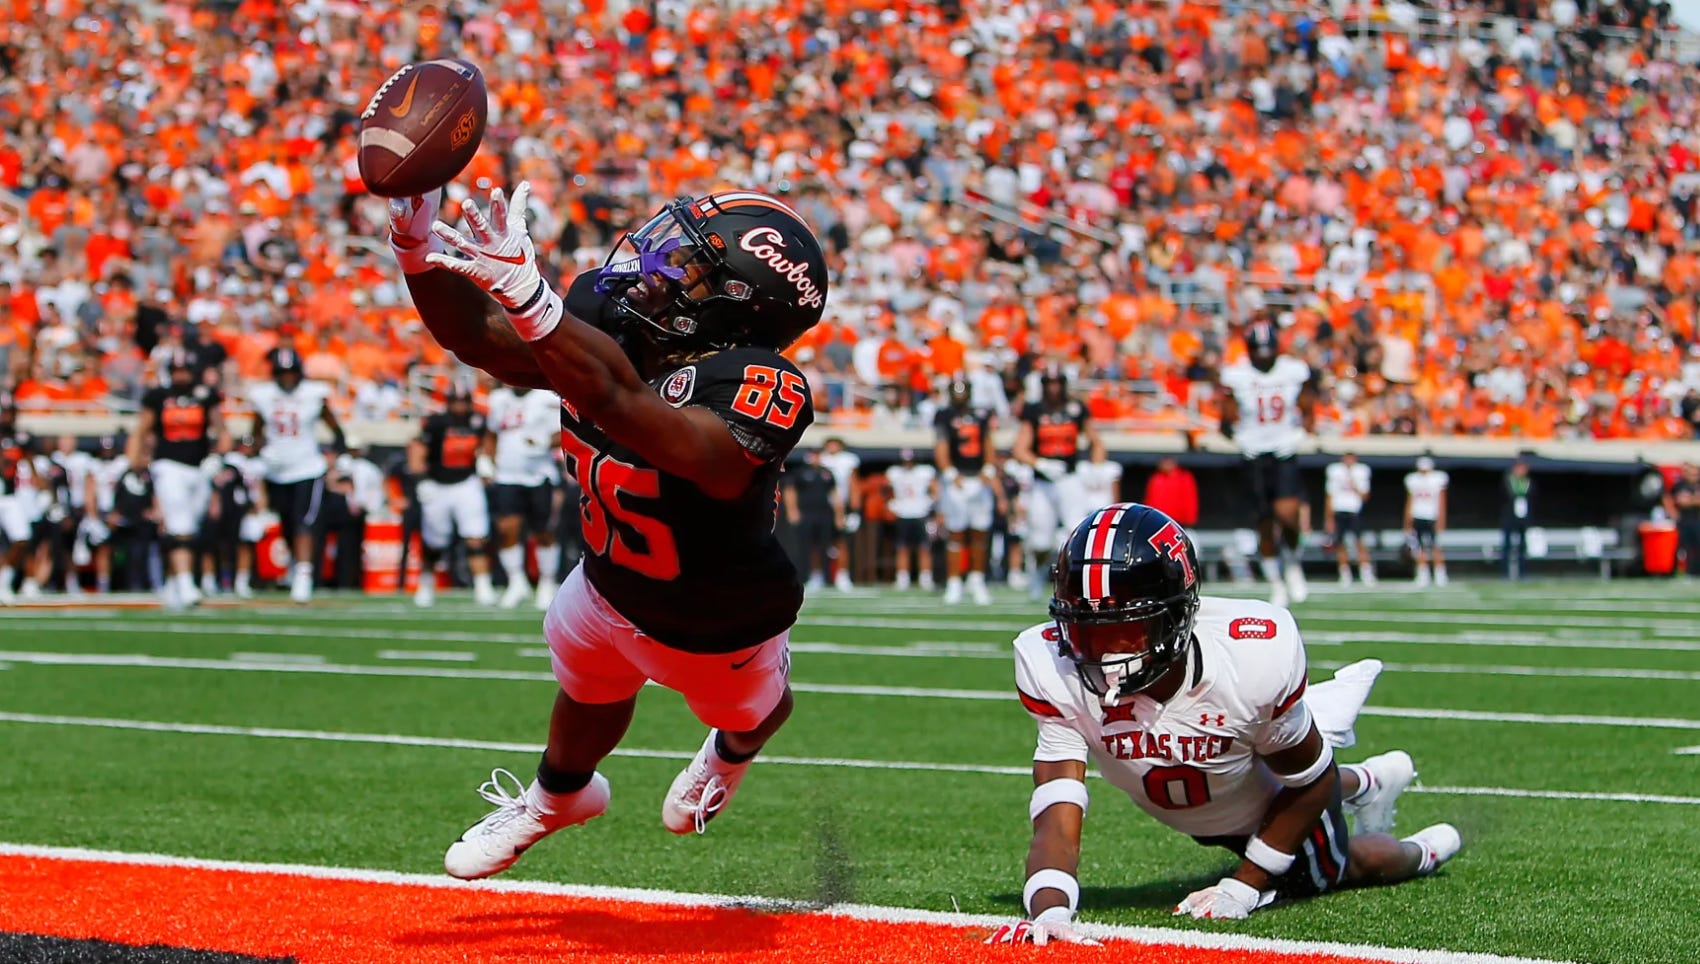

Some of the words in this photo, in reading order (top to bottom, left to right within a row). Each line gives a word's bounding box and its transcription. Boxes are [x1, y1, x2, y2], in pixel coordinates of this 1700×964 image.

[739, 226, 823, 310] Cowboys
[731, 365, 806, 430] 85
[1257, 394, 1284, 423] 19
[560, 427, 681, 581] 85
[1229, 618, 1277, 640] 0
[1101, 730, 1173, 761] TEXAS
[1142, 765, 1212, 810] 0
